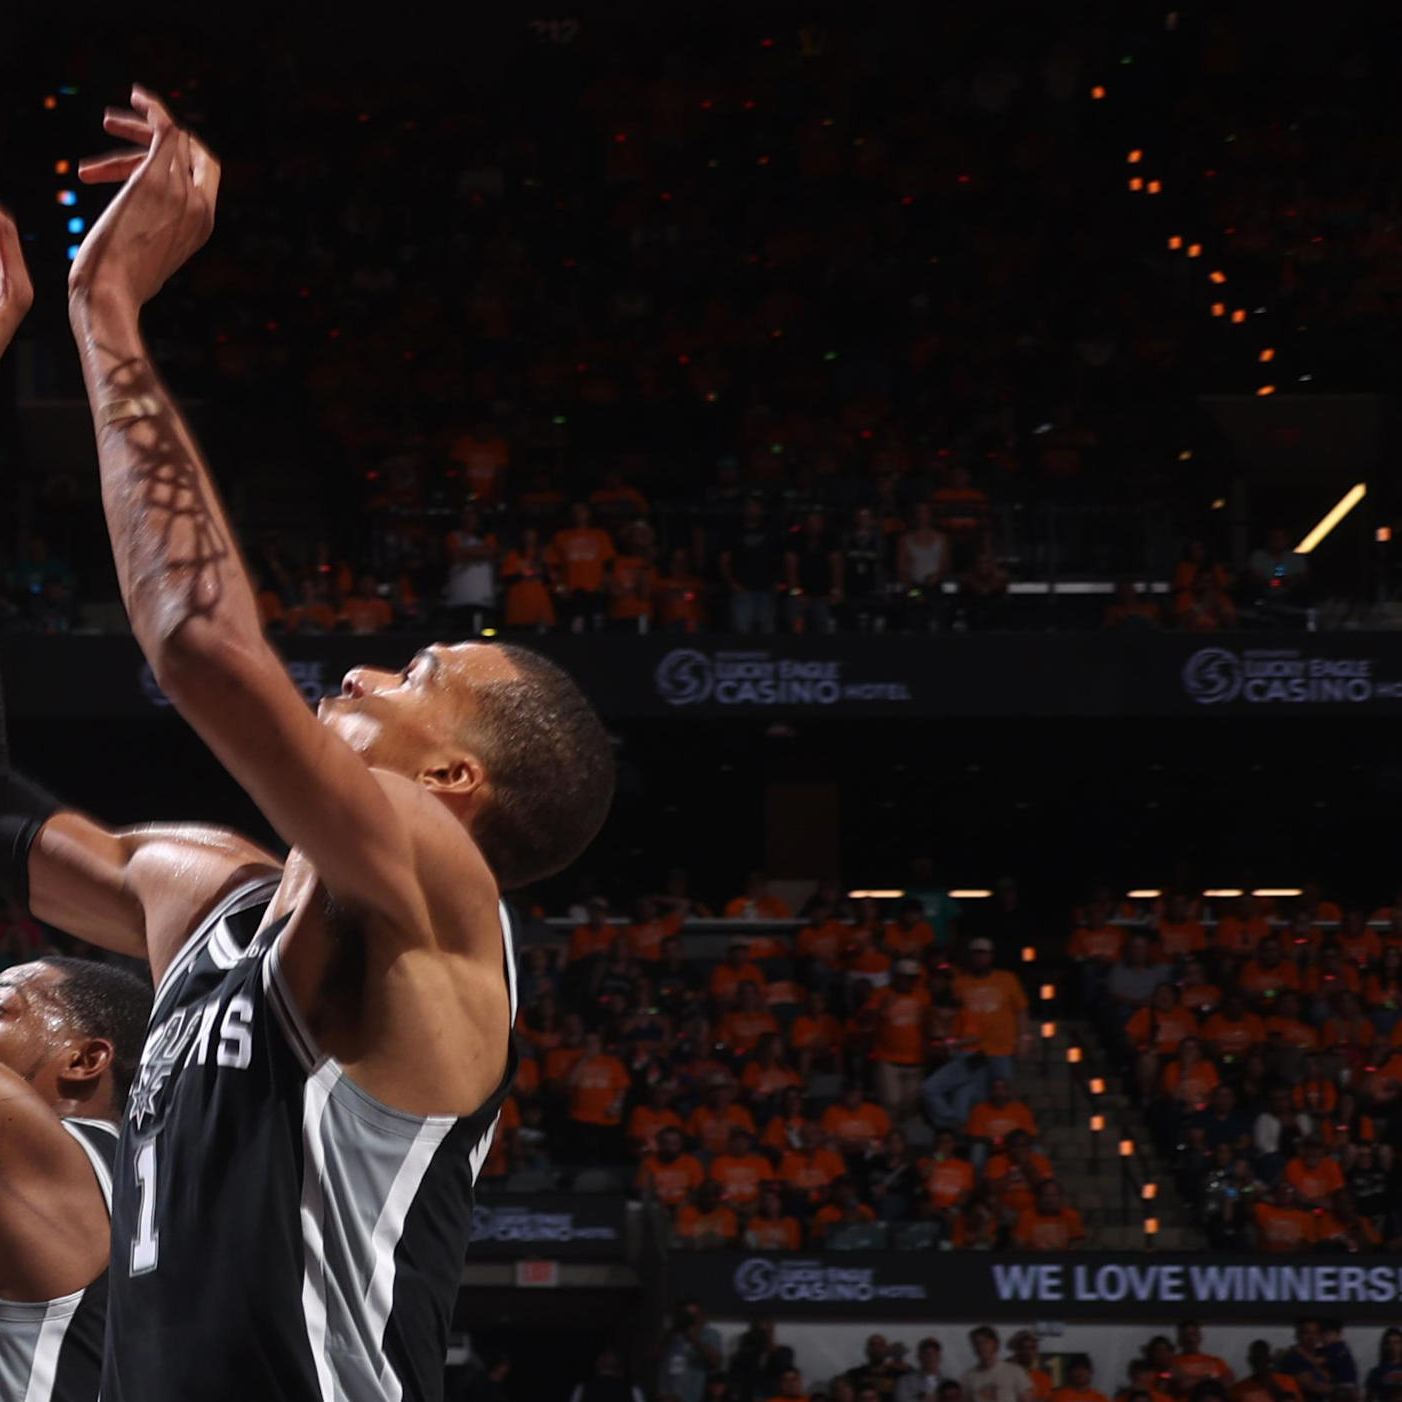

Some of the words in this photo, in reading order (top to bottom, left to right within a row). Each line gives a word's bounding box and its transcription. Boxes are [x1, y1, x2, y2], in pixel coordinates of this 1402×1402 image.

[715, 680, 840, 704] CASINO
[1244, 678, 1372, 703] CASINO
[128, 1137, 161, 1279] 1
[992, 1264, 1065, 1301] WE
[1073, 1264, 1186, 1302] LOVE
